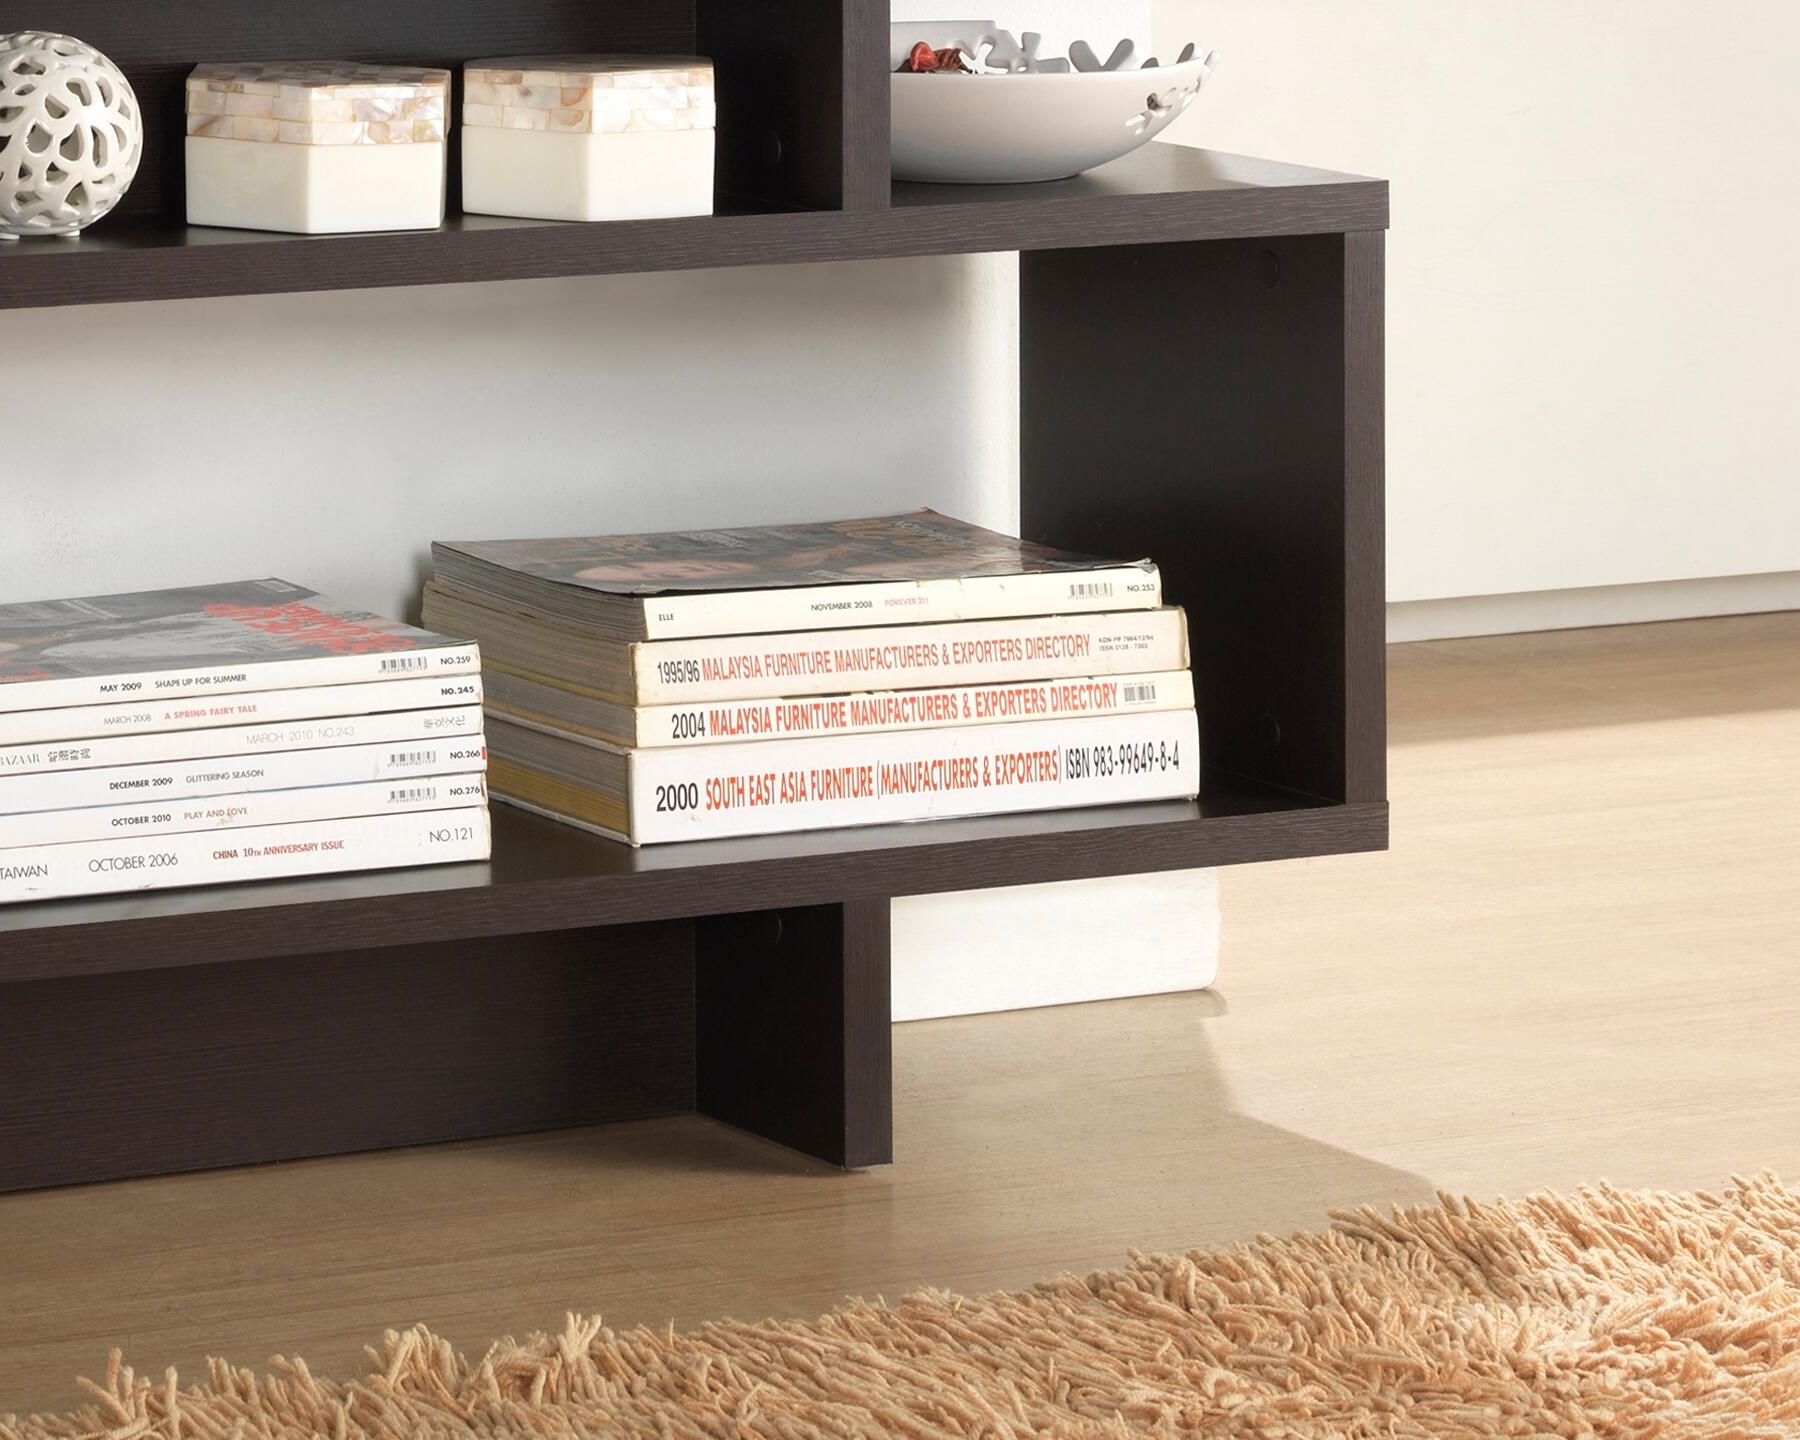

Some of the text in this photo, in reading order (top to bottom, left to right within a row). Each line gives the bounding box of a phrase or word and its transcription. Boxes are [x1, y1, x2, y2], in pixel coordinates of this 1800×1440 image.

[811, 602, 852, 611] NOVEMBER
[885, 598, 917, 606] FOREVER
[1127, 584, 1155, 592] NO.253
[100, 684, 118, 692] MAY
[121, 682, 142, 691] 2009
[155, 679, 180, 688] SHAPE
[182, 678, 193, 686] UP
[195, 677, 211, 685] FOR
[213, 674, 246, 684] SUMMER
[441, 656, 470, 664] NO.259
[658, 634, 1089, 684] 1995/96 MALAYSIA FURNITURE MANUFACTURERS & EXPORTERS DIRECTORY
[104, 716, 131, 725] MARCH
[133, 714, 151, 723] 2008
[174, 709, 206, 719] SPRING
[210, 707, 234, 715] FAIRY
[237, 705, 256, 713] TALE
[441, 686, 474, 695] NO.245
[672, 683, 1117, 739] 2004 MALAYSIA FURNITURE MANUFACTURERS & EXPORTERS DIRECTORY
[246, 732, 283, 744] MARCH
[288, 730, 313, 741] 2010
[318, 726, 355, 738] NO.243
[110, 780, 149, 790] DECEMBER
[152, 777, 173, 786] 2009
[186, 772, 230, 783] GLITTERING
[232, 769, 264, 779] SEASON
[450, 750, 480, 759] NO.266
[656, 741, 1179, 812] 2000 SOUTH EAST ASIA FURNITURE (MANUFACTURERS & EXPORTERS) ISBN 983-99649-8-4
[112, 816, 149, 826] OCTOBER
[152, 814, 171, 822] 2010
[184, 811, 203, 820] PLAY
[227, 808, 247, 817] LOVE
[450, 786, 480, 795] NO.276
[88, 856, 145, 872] OCTOBER
[149, 853, 178, 867] 2006
[213, 850, 238, 860] CHINA
[264, 843, 318, 855] ANNIVERSARY
[321, 840, 344, 850] ISSUE
[430, 827, 472, 842] NO.121
